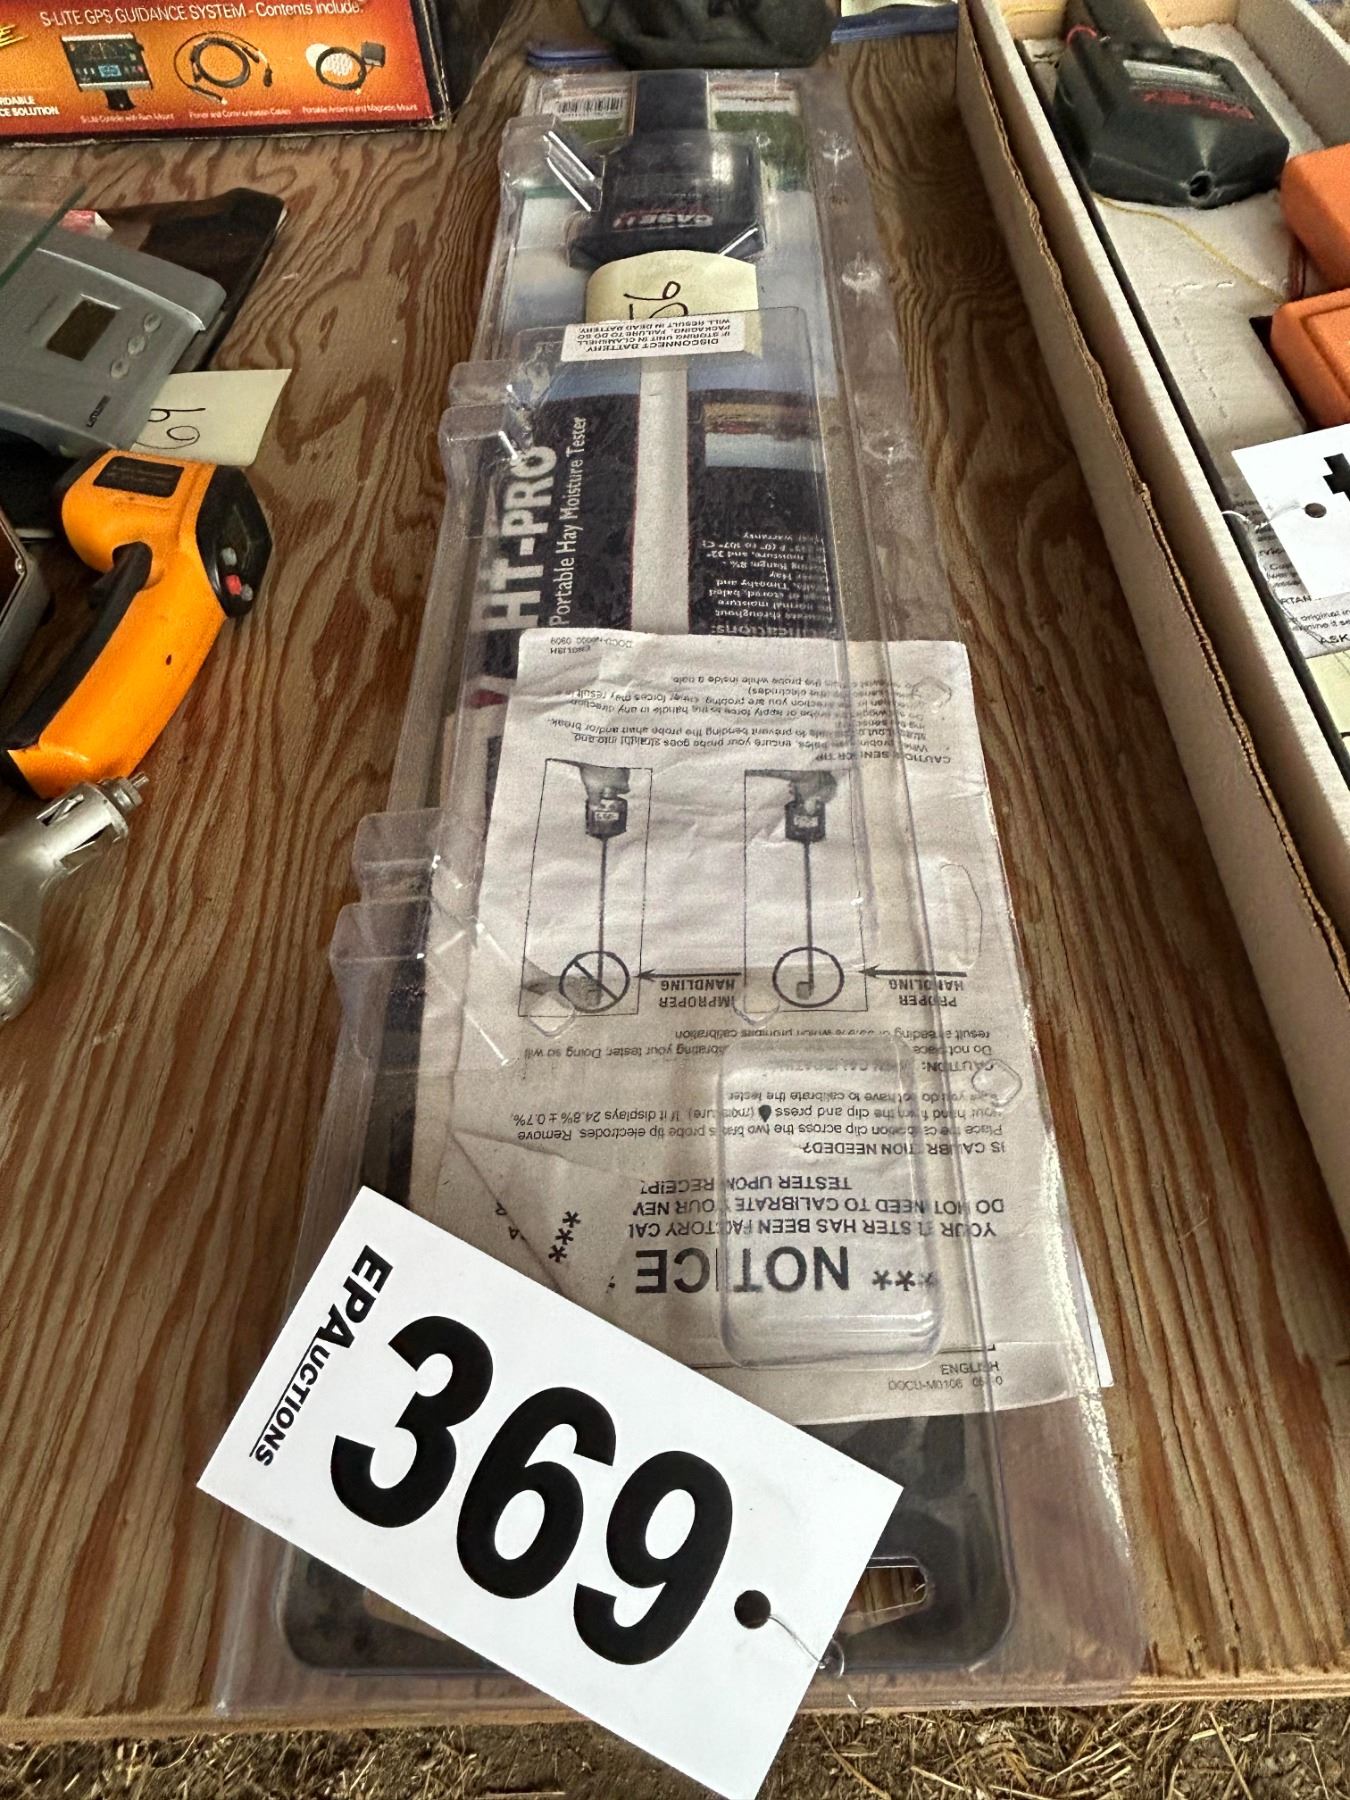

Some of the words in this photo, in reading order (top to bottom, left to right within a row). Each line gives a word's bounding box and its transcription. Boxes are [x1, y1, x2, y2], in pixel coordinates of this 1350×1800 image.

[40, 10, 80, 26] S-LITE
[85, 10, 113, 24] GPS
[115, 7, 187, 22] GUIDANCE
[191, 5, 246, 20] SYSTEM
[255, 3, 313, 17] Contents
[12, 106, 59, 116] SOLUTION
[638, 214, 713, 227] CASE
[625, 323, 653, 331] DEAD
[667, 320, 704, 328] RESULT
[671, 325, 730, 334] PACKAGING.
[625, 329, 666, 337] FAILURE
[650, 334, 673, 342] UNIT
[675, 332, 719, 340] STORING
[577, 337, 635, 346] CLAMSHELL
[641, 338, 718, 349] DISCONNECT
[585, 343, 638, 352] BATTERY
[566, 416, 586, 456] Tester
[559, 460, 583, 522] Moisture
[471, 445, 557, 632] HT-PRO
[556, 523, 584, 554] Hay
[743, 532, 792, 540] warranty
[769, 571, 792, 580] Hay
[740, 580, 788, 589] Timothy
[550, 554, 575, 627] Portable
[708, 589, 740, 597] baled
[715, 609, 781, 619] throughout
[707, 676, 738, 684] inside
[576, 689, 607, 699] result
[634, 694, 666, 702] forces
[768, 698, 788, 706] you
[617, 704, 637, 714] any
[754, 708, 783, 716] apply
[585, 724, 619, 734] and/or
[651, 727, 682, 736] probe
[686, 728, 702, 737] the
[706, 727, 748, 736] bending
[751, 728, 792, 736] prevent
[663, 738, 689, 747] goes
[693, 738, 724, 746] probe
[727, 737, 751, 747] your
[660, 979, 736, 991] HANDLING
[888, 978, 964, 991] HANDLING
[658, 996, 735, 1008] IMPROPER
[955, 1030, 990, 1041] result
[524, 1049, 543, 1058] will
[547, 1049, 560, 1057] so
[566, 1046, 601, 1059] Doing
[646, 1044, 673, 1056] your
[947, 1045, 969, 1056] not
[973, 1045, 992, 1056] Do
[766, 1093, 786, 1104] the
[790, 1093, 845, 1104] calibrate
[848, 1093, 860, 1103] to
[922, 1093, 939, 1104] do
[605, 1108, 656, 1122] displays
[659, 1111, 667, 1122] it
[775, 1106, 813, 1117] press
[817, 1107, 842, 1119] and
[847, 1106, 869, 1119] clip
[561, 1111, 601, 1124] 24.8%
[650, 1126, 664, 1138] tip
[669, 1126, 705, 1137] probe
[748, 1124, 770, 1135] two
[774, 1123, 794, 1135] the
[799, 1123, 841, 1134] across
[845, 1123, 868, 1135] clip
[965, 1124, 1003, 1135] Place
[518, 1130, 572, 1141] Remove
[802, 1142, 877, 1154] NEEDED?
[990, 1141, 1005, 1154] IS
[726, 1176, 772, 1191] UPON
[778, 1175, 852, 1190] TESTER
[735, 1197, 838, 1213] CALIBRATE
[845, 1198, 870, 1212] TO
[875, 1198, 926, 1214] NEED
[976, 1198, 1004, 1213] DO
[758, 1219, 810, 1234] BEEN
[816, 1219, 856, 1234] HAS
[635, 1246, 849, 1294] NOTICE
[330, 1315, 734, 1666] 369
